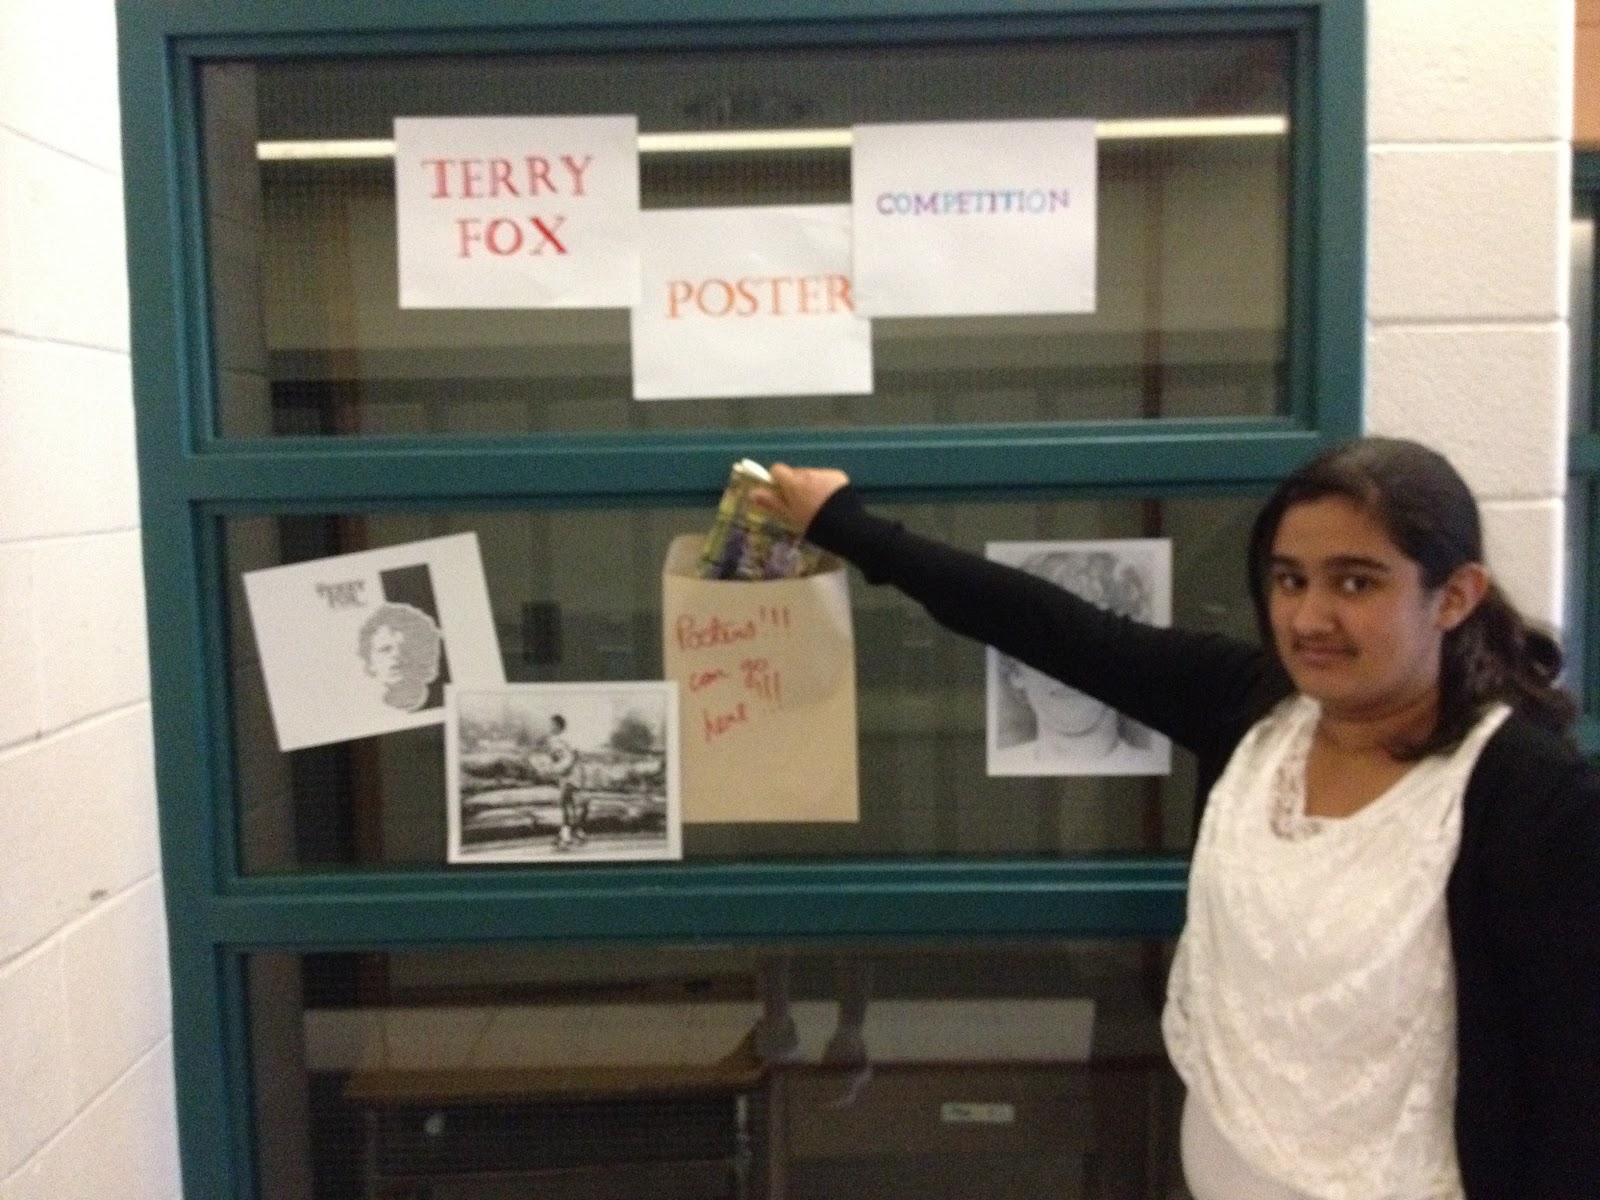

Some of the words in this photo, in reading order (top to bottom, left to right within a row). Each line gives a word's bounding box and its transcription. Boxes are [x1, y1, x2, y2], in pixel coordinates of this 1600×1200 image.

[420, 153, 594, 199] TERRY
[876, 186, 1070, 217] COMPETITION
[455, 215, 570, 258] FOX
[665, 273, 854, 319] POSTER
